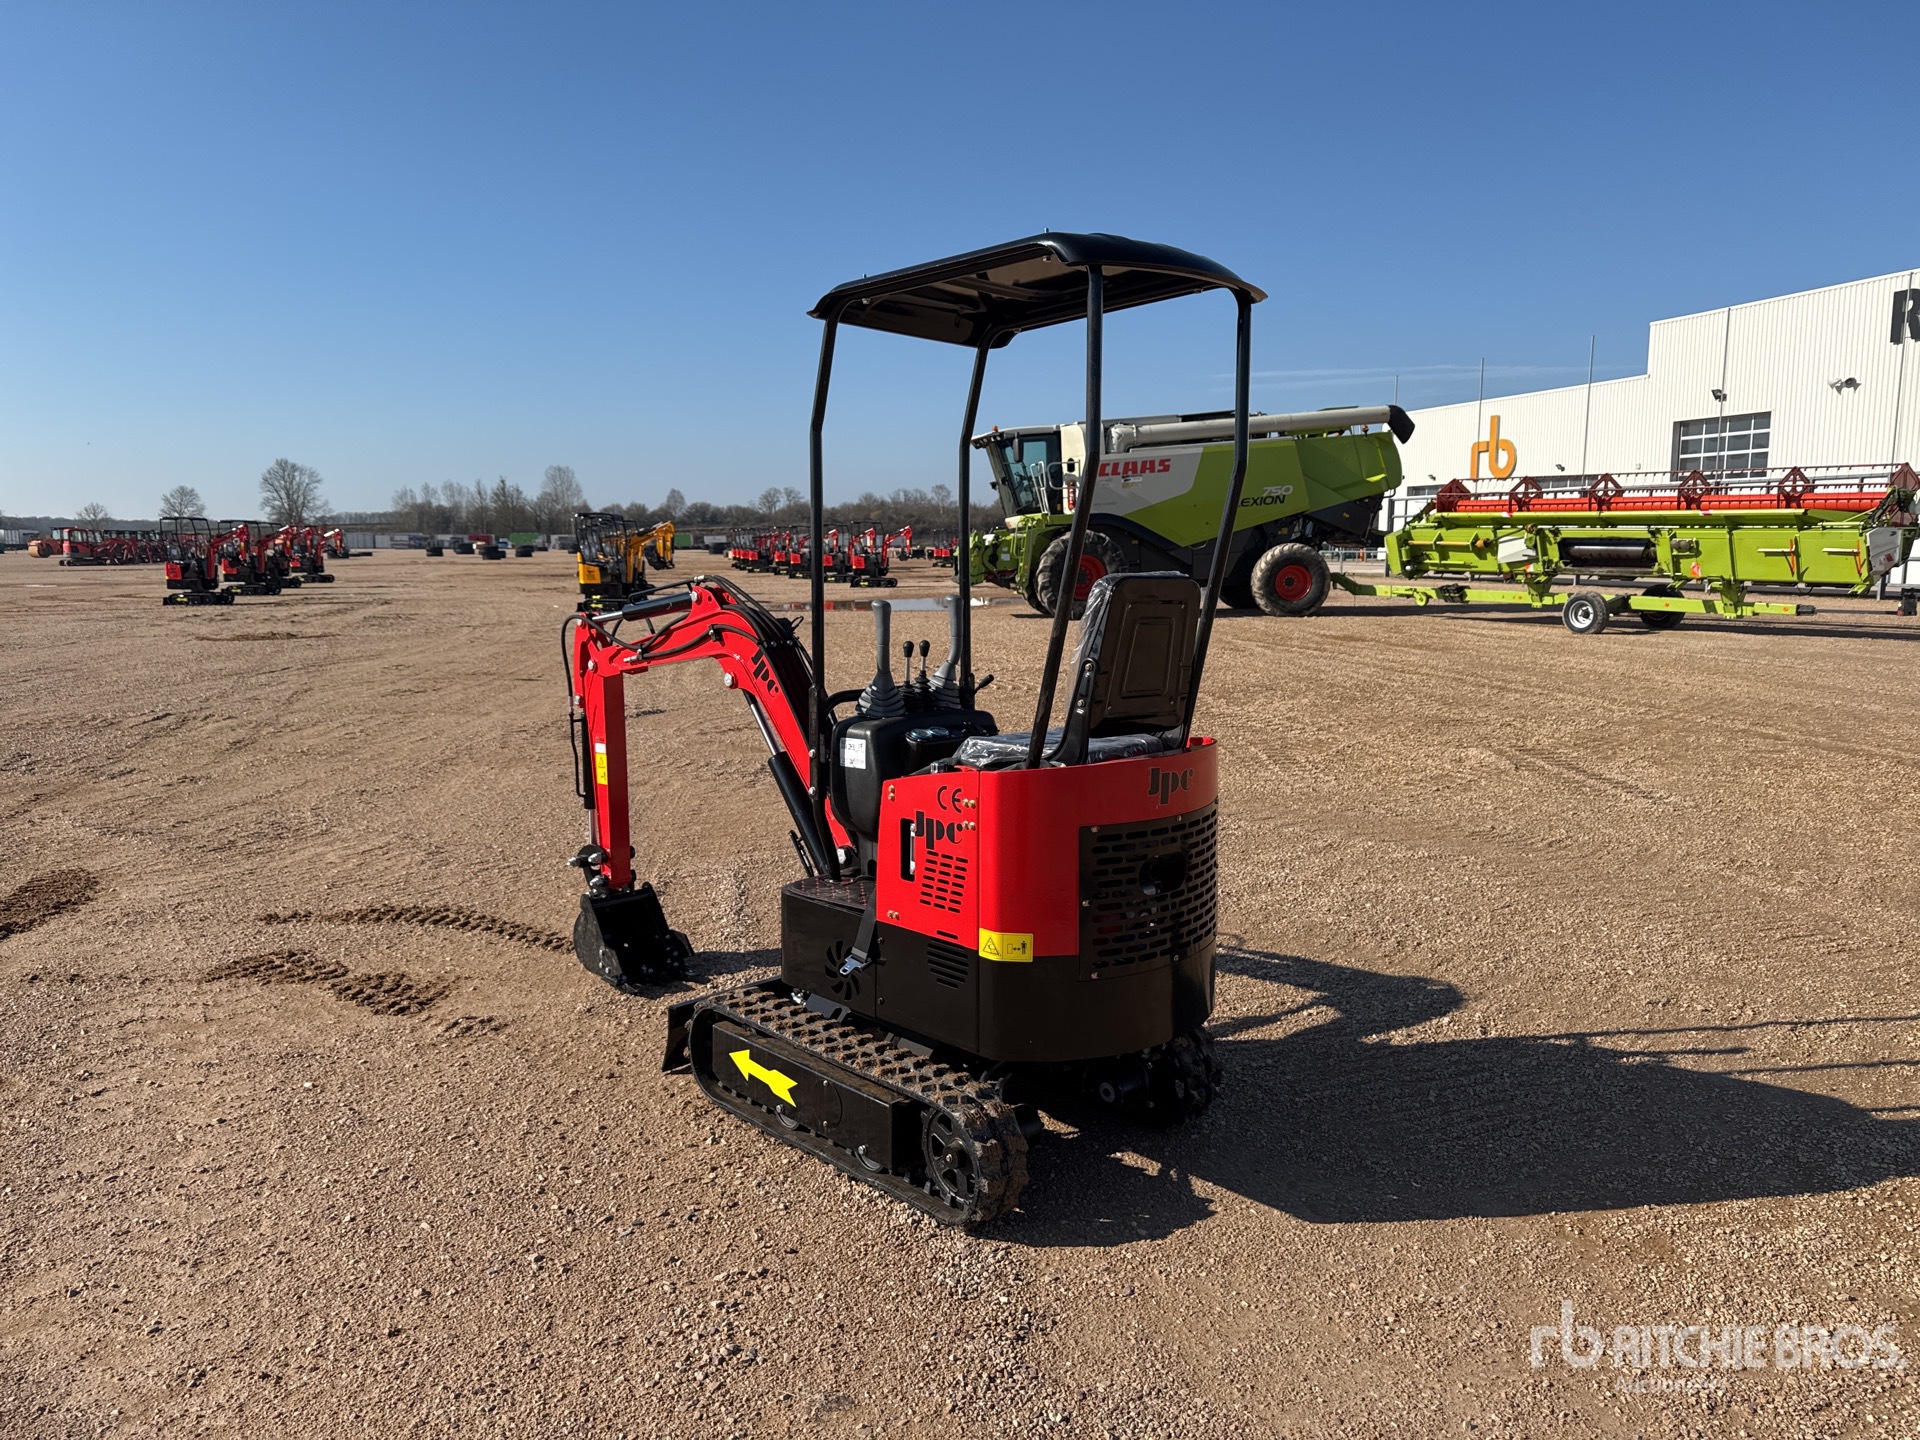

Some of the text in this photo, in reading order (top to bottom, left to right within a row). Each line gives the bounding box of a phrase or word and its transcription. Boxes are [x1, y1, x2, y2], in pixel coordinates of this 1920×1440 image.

[1470, 415, 1517, 480] rb
[1099, 459, 1171, 477] CLAAS
[1263, 485, 1293, 496] 750
[1239, 495, 1286, 507] EXION
